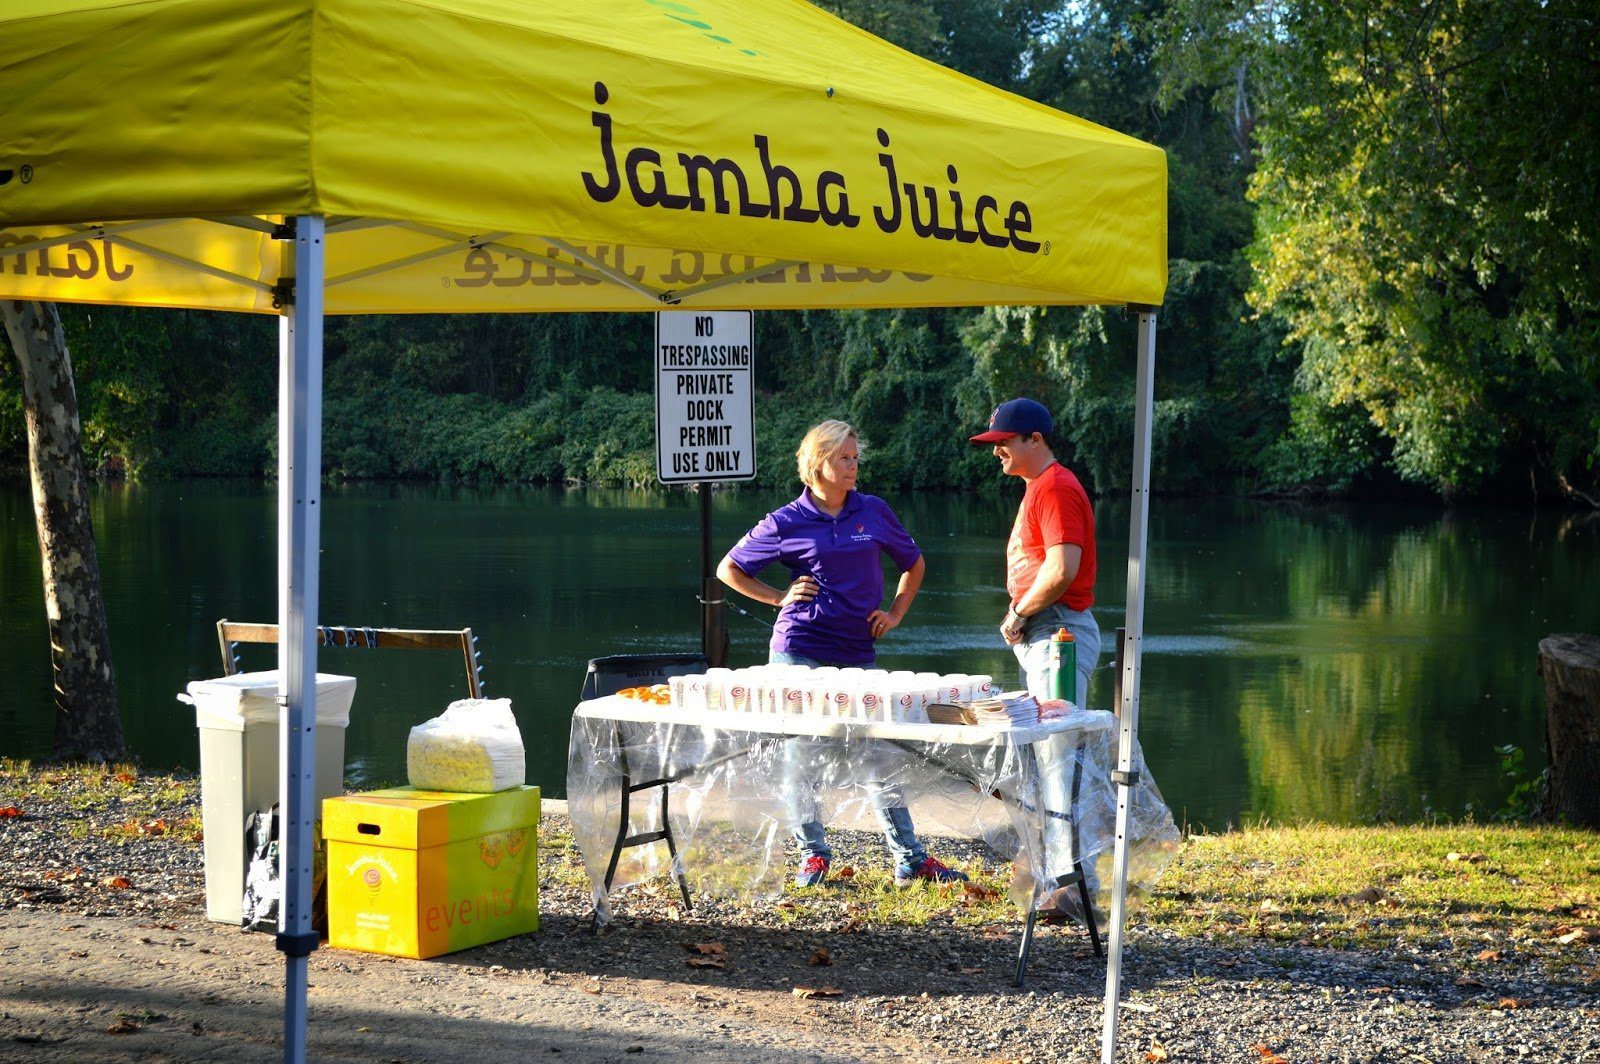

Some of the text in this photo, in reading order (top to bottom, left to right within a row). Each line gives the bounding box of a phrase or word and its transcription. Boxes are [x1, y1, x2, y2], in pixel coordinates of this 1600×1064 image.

[581, 81, 861, 228] jamba
[695, 316, 714, 337] NO
[661, 345, 749, 366] TRESPASSING
[676, 374, 734, 395] PRIVATE
[687, 400, 724, 421] DOCK
[680, 425, 732, 447] PERMIT
[672, 451, 741, 474] USE ONLY
[426, 887, 516, 932] events
